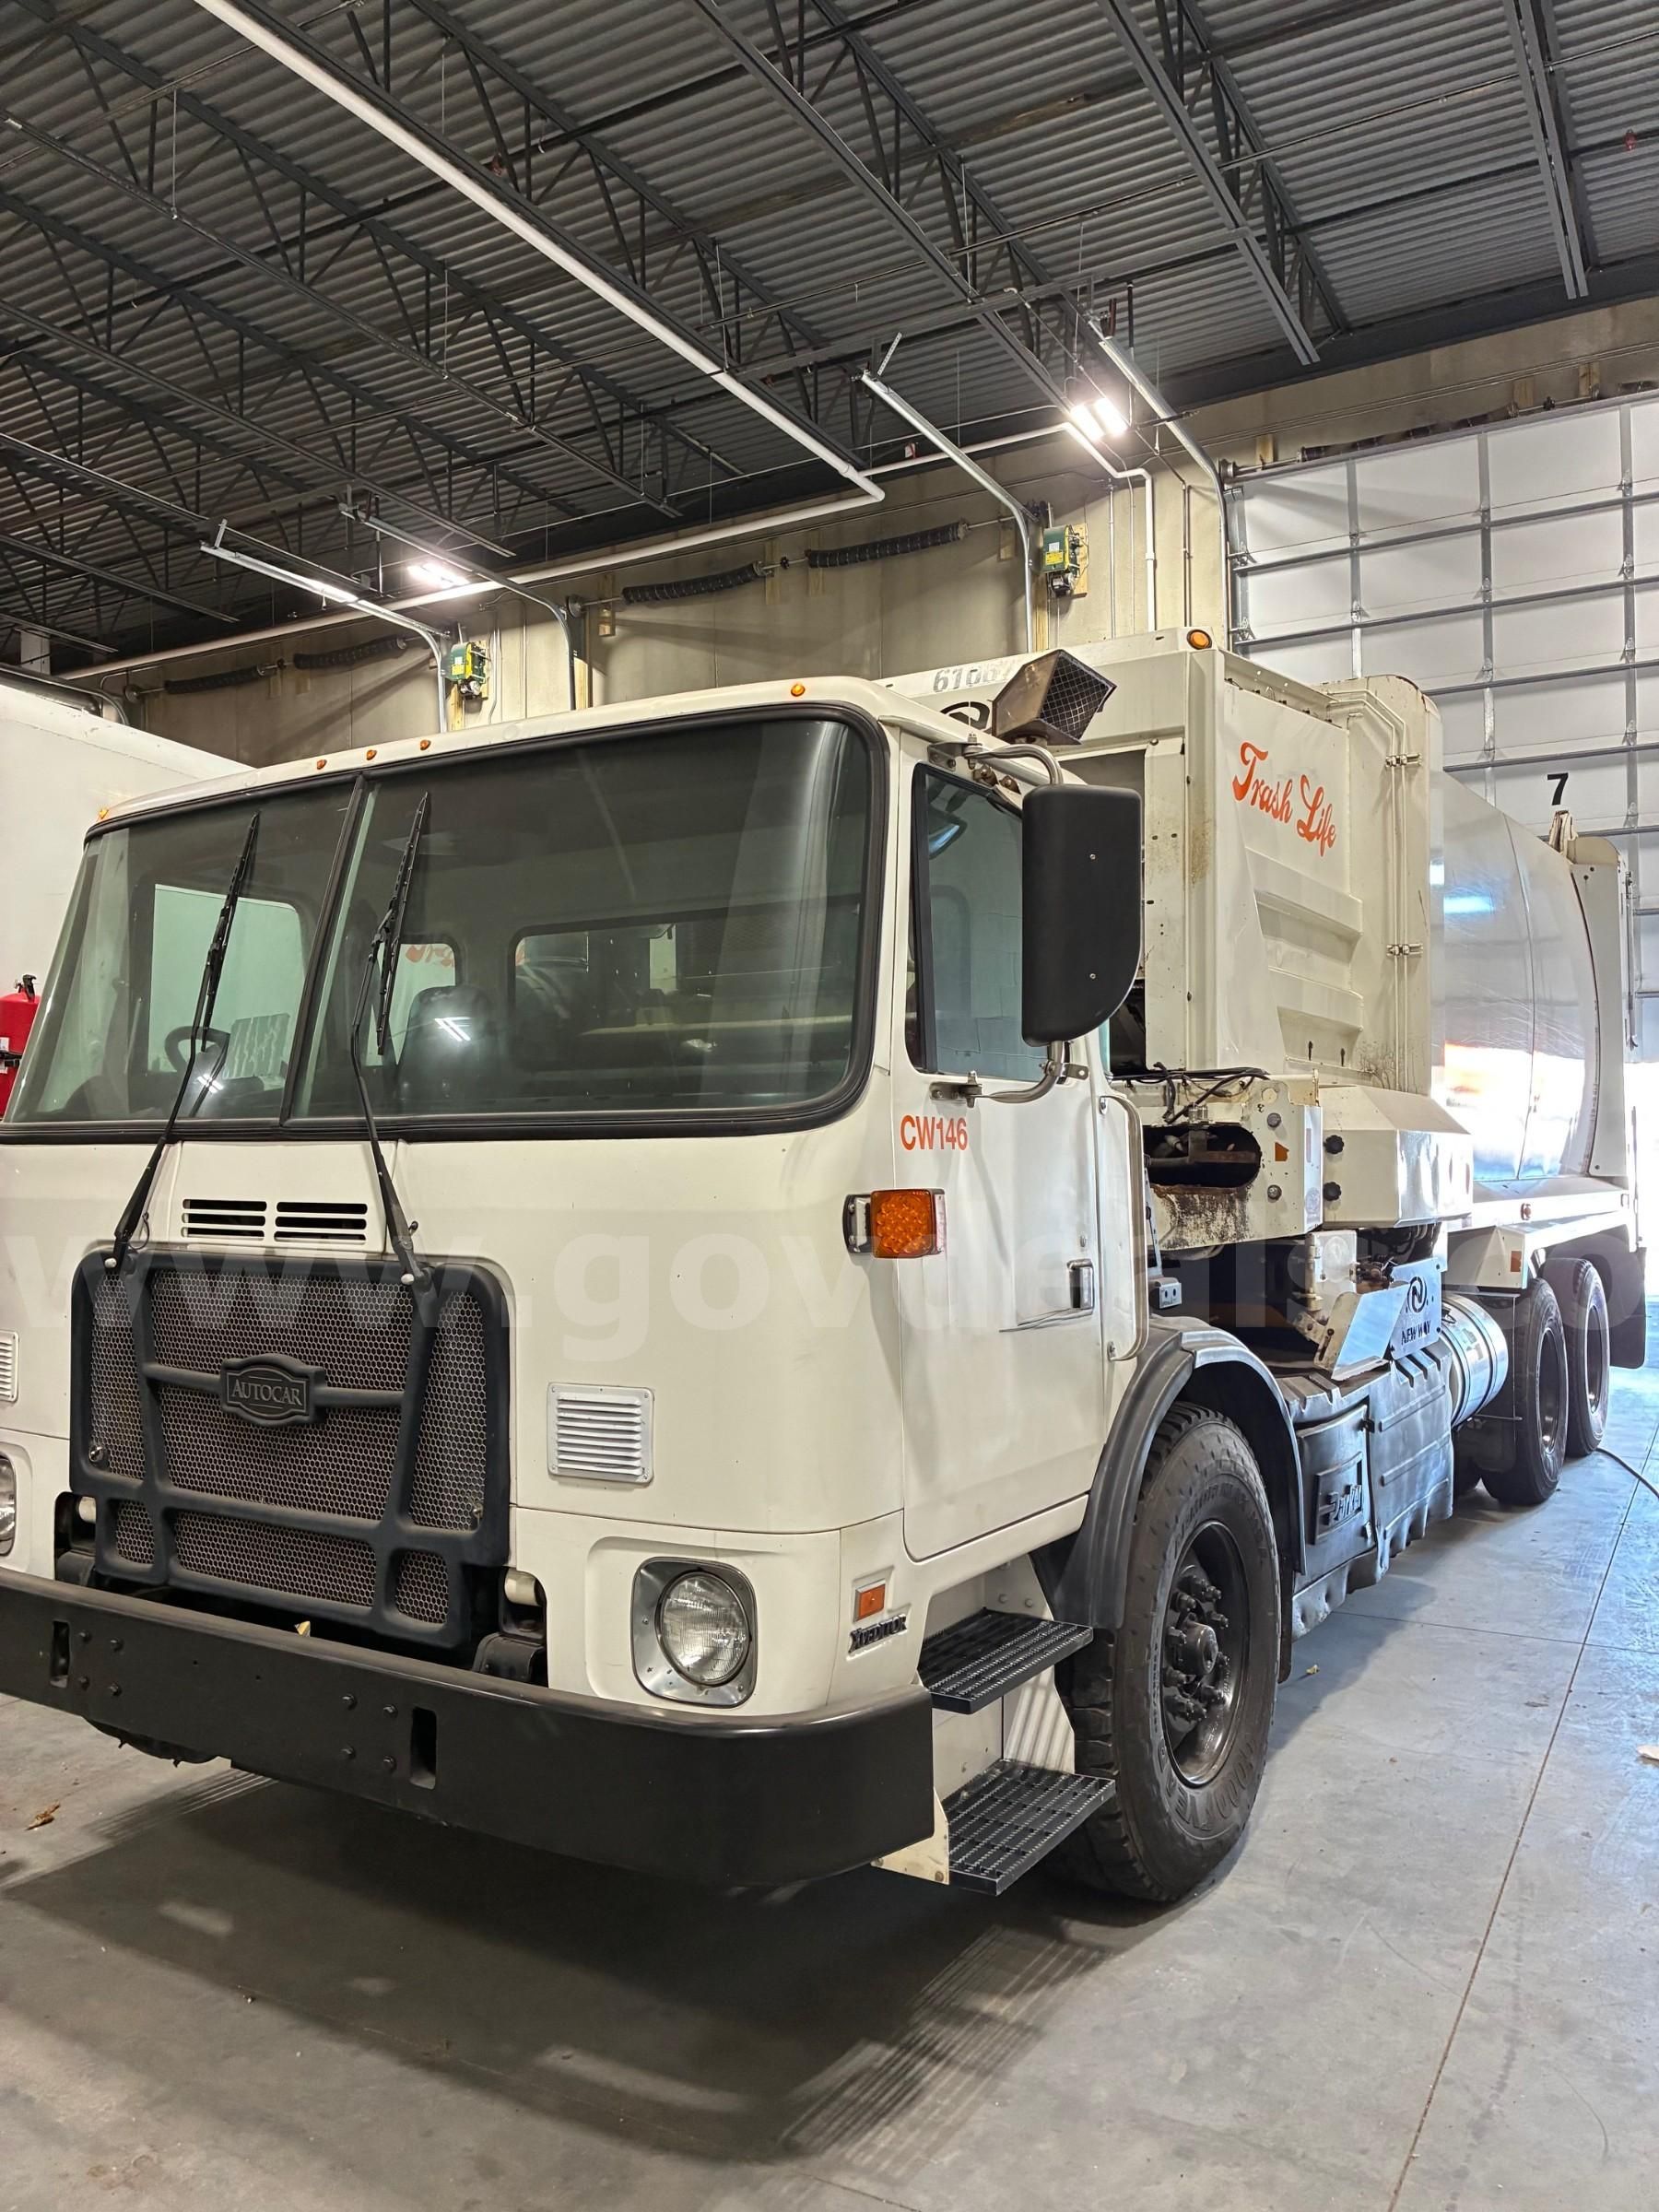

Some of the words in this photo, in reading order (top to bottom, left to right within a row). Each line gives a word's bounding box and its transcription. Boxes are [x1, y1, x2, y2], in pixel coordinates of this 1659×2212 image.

[1232, 742, 1292, 823] Trash
[1297, 774, 1336, 856] Life
[1547, 772, 1569, 806] 7
[900, 1114, 968, 1150] CW146
[1401, 1327, 1418, 1346] NEW
[230, 1379, 303, 1406] AUTOCAR
